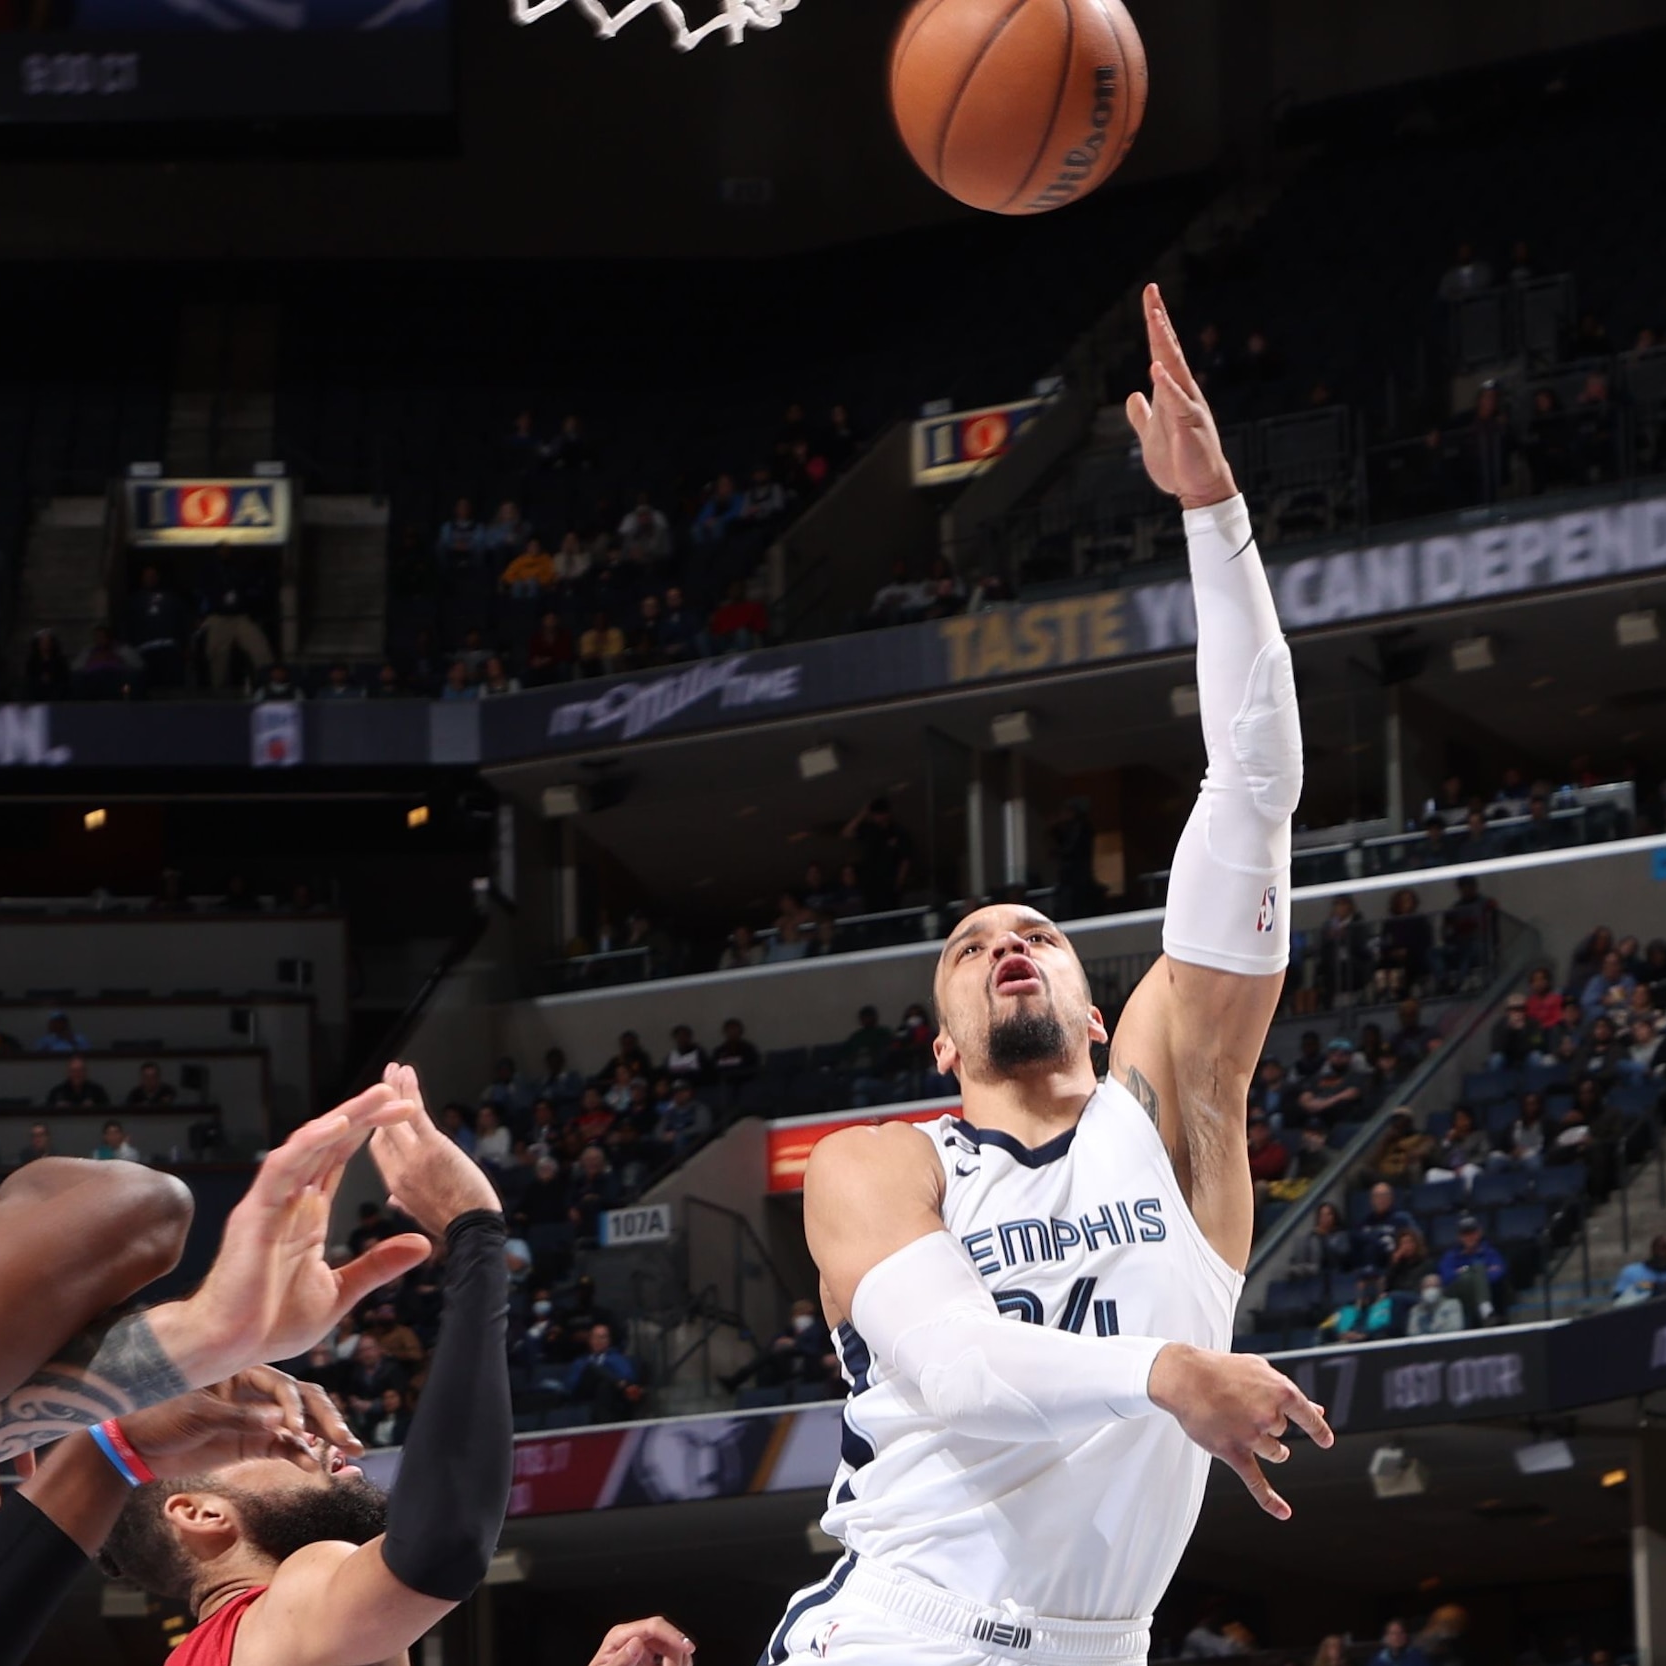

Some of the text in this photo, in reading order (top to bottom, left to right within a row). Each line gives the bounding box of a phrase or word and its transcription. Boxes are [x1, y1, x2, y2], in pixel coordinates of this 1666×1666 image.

[940, 588, 1126, 682] TASTE
[1278, 542, 1424, 628] CAN
[611, 1209, 665, 1239] 107A
[961, 1198, 1166, 1276] EMPHIS
